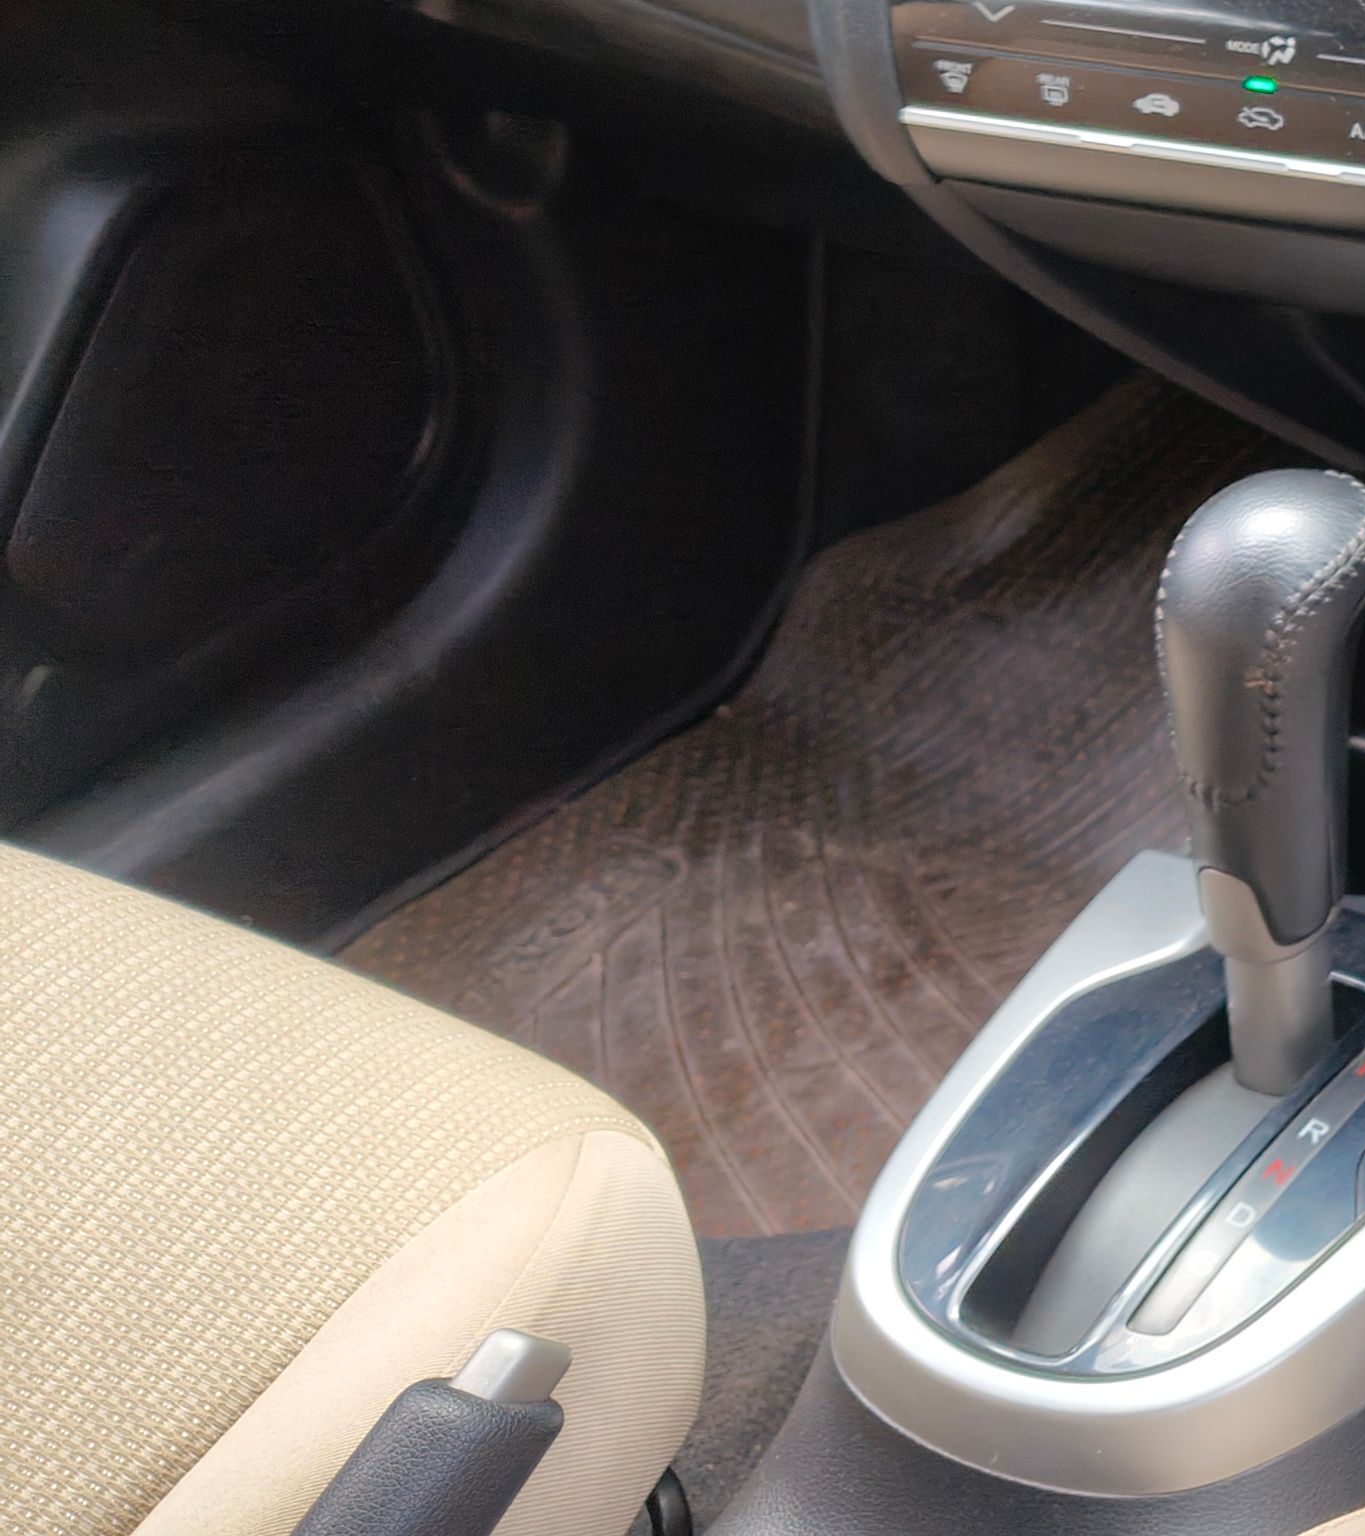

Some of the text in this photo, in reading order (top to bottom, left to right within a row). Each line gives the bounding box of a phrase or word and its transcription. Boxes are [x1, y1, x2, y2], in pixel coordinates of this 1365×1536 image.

[1298, 1117, 1331, 1144] R
[1261, 1159, 1297, 1186] N
[1224, 1202, 1257, 1229] D
